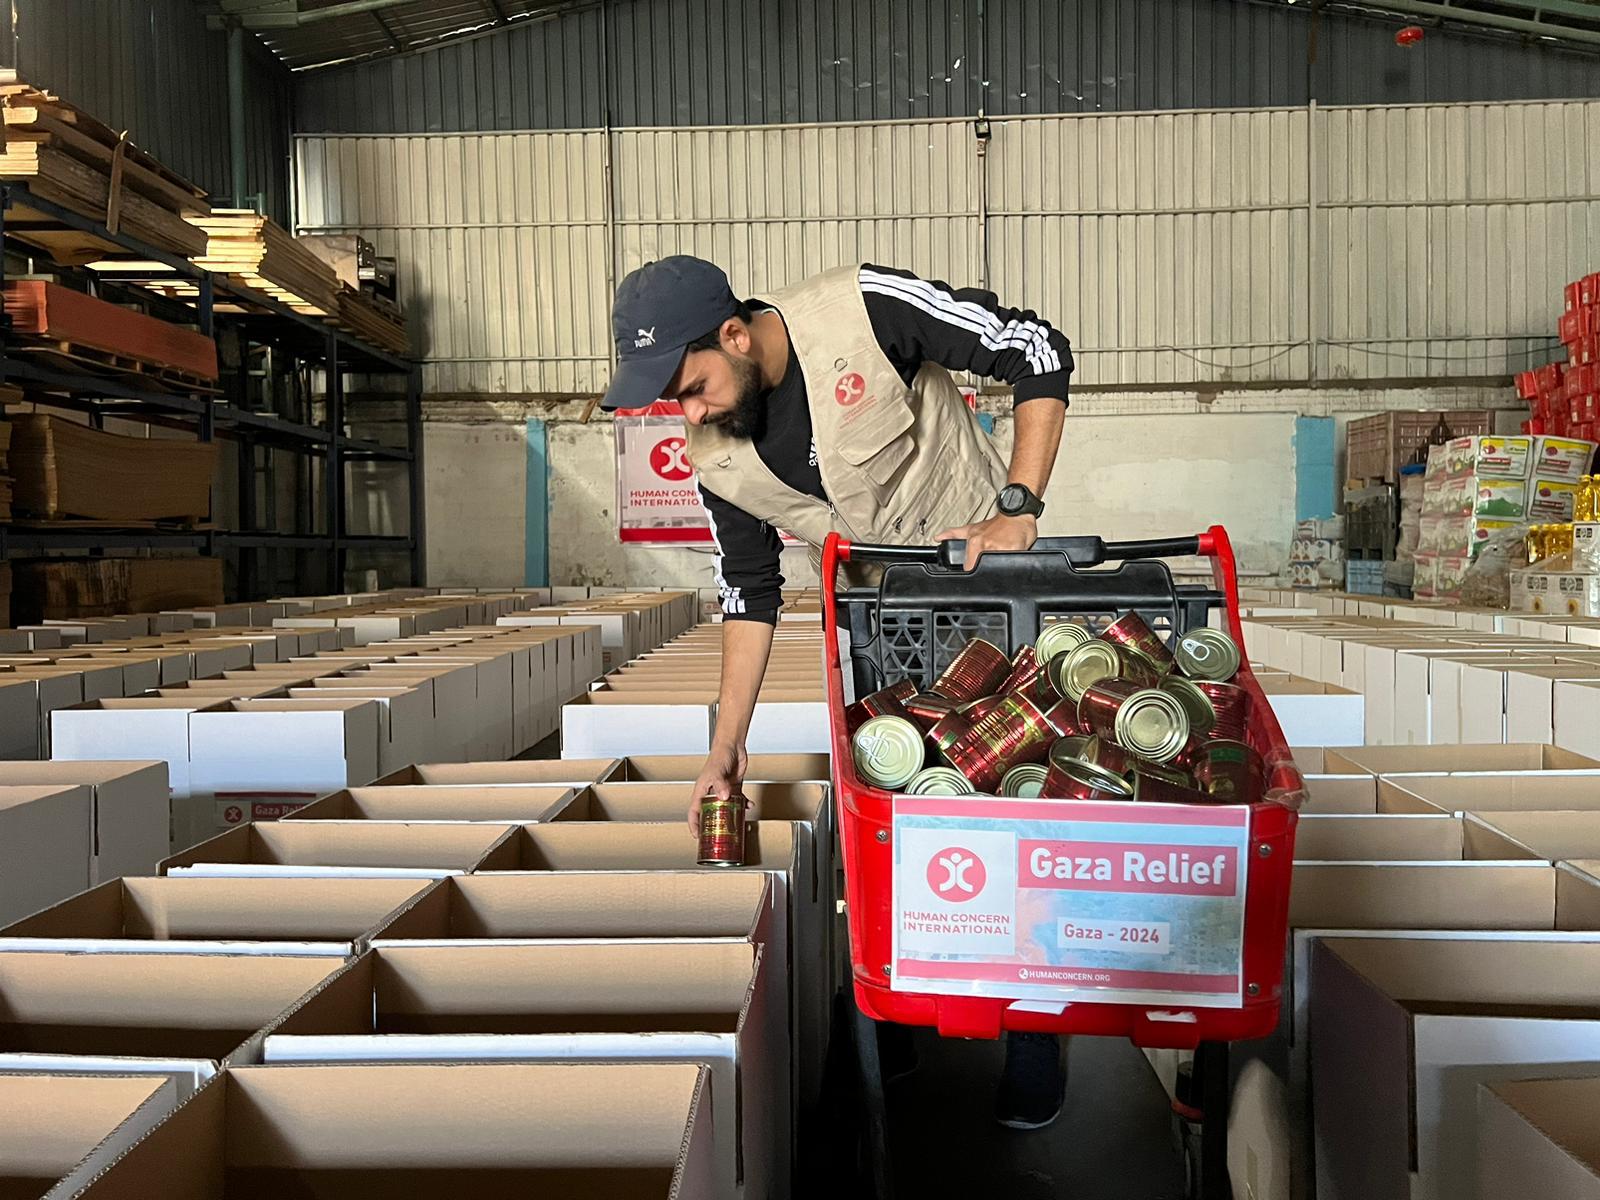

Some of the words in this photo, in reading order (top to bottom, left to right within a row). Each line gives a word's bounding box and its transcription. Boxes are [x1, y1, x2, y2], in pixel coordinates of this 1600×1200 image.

[630, 490, 669, 498] HUMAN
[255, 805, 280, 815] Gaza
[1030, 847, 1112, 881] Gaza
[1123, 851, 1226, 885] Relief
[903, 911, 948, 922] HUMAN
[951, 914, 1010, 924] CONCERN
[903, 921, 1011, 935] INTERNATIONAL
[1064, 923, 1103, 940] Gaza
[1119, 927, 1160, 944] 2024
[1029, 970, 1111, 982] HUMANCONCERN.ORG
